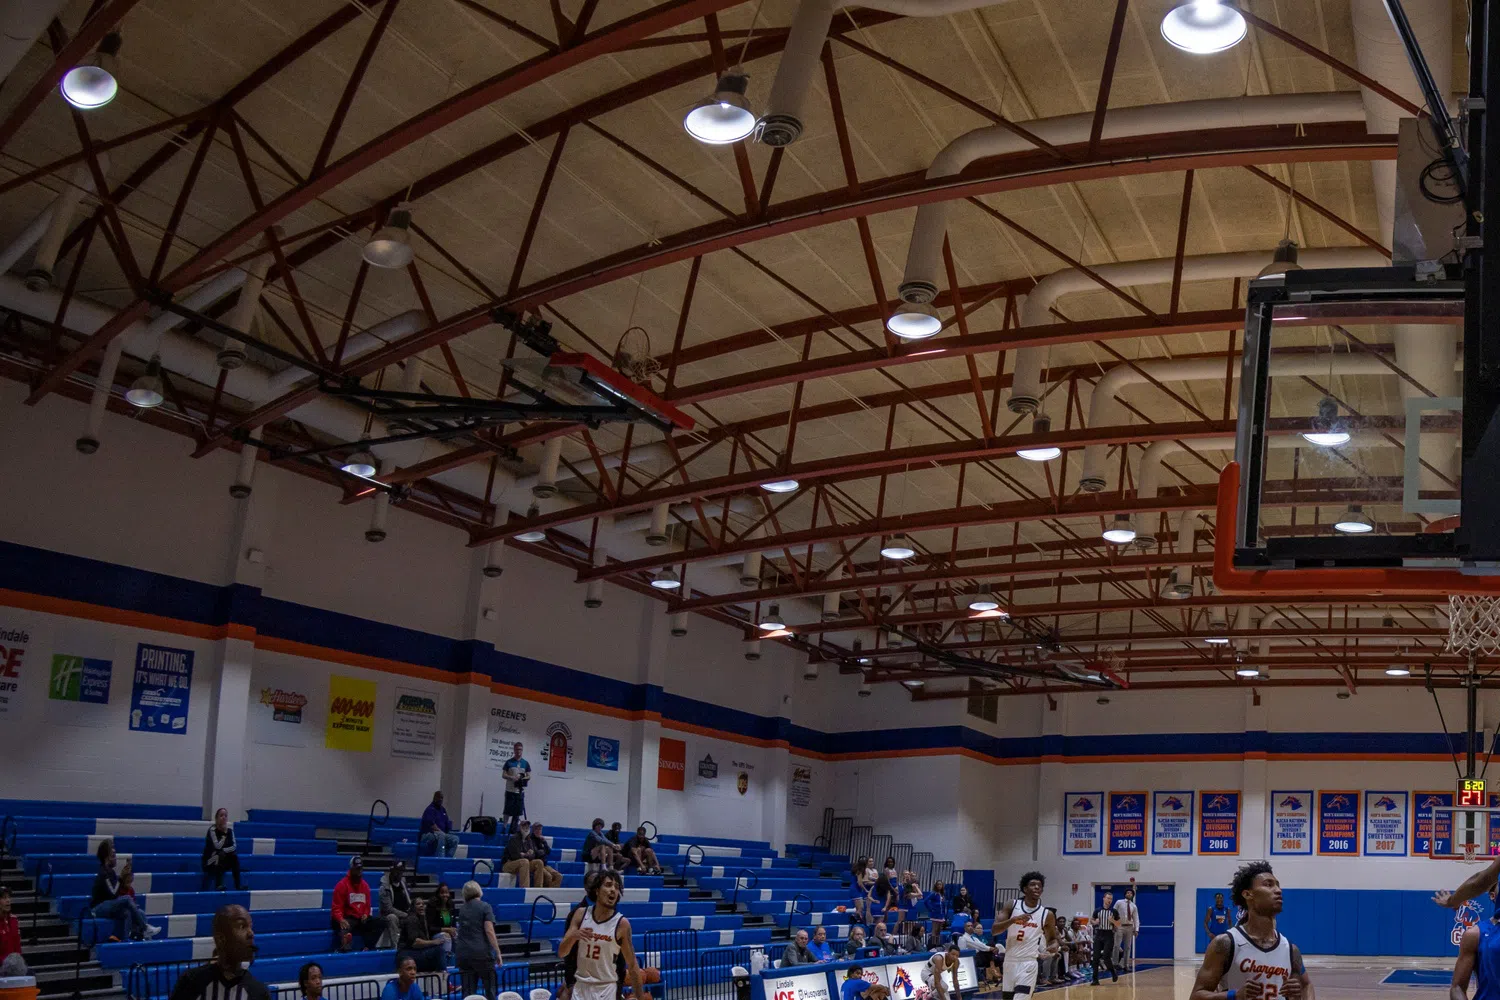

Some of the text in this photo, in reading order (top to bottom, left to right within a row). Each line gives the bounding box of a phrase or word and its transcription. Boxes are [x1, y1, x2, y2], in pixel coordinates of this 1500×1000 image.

[141, 648, 188, 673] PRINTING.
[149, 672, 168, 687] WHAT
[168, 674, 178, 689] WE
[490, 708, 527, 722] GREENE'S
[332, 722, 370, 734] EXPRESS WASH
[1464, 780, 1484, 791] 6:20
[1462, 790, 1481, 805] 27
[1074, 839, 1092, 849] 2015
[1118, 839, 1136, 849] 2015
[1162, 839, 1181, 849] 2016
[1209, 839, 1229, 849] 2016
[1281, 839, 1301, 849] 2016
[1328, 840, 1349, 850] 2016
[1375, 840, 1396, 850] 2017
[1423, 840, 1443, 850] 217
[1016, 930, 1025, 942] 2
[585, 943, 601, 960] 12
[1239, 958, 1289, 981] Chargers
[776, 980, 794, 989] Lindale
[804, 988, 827, 1000] Husqvarna
